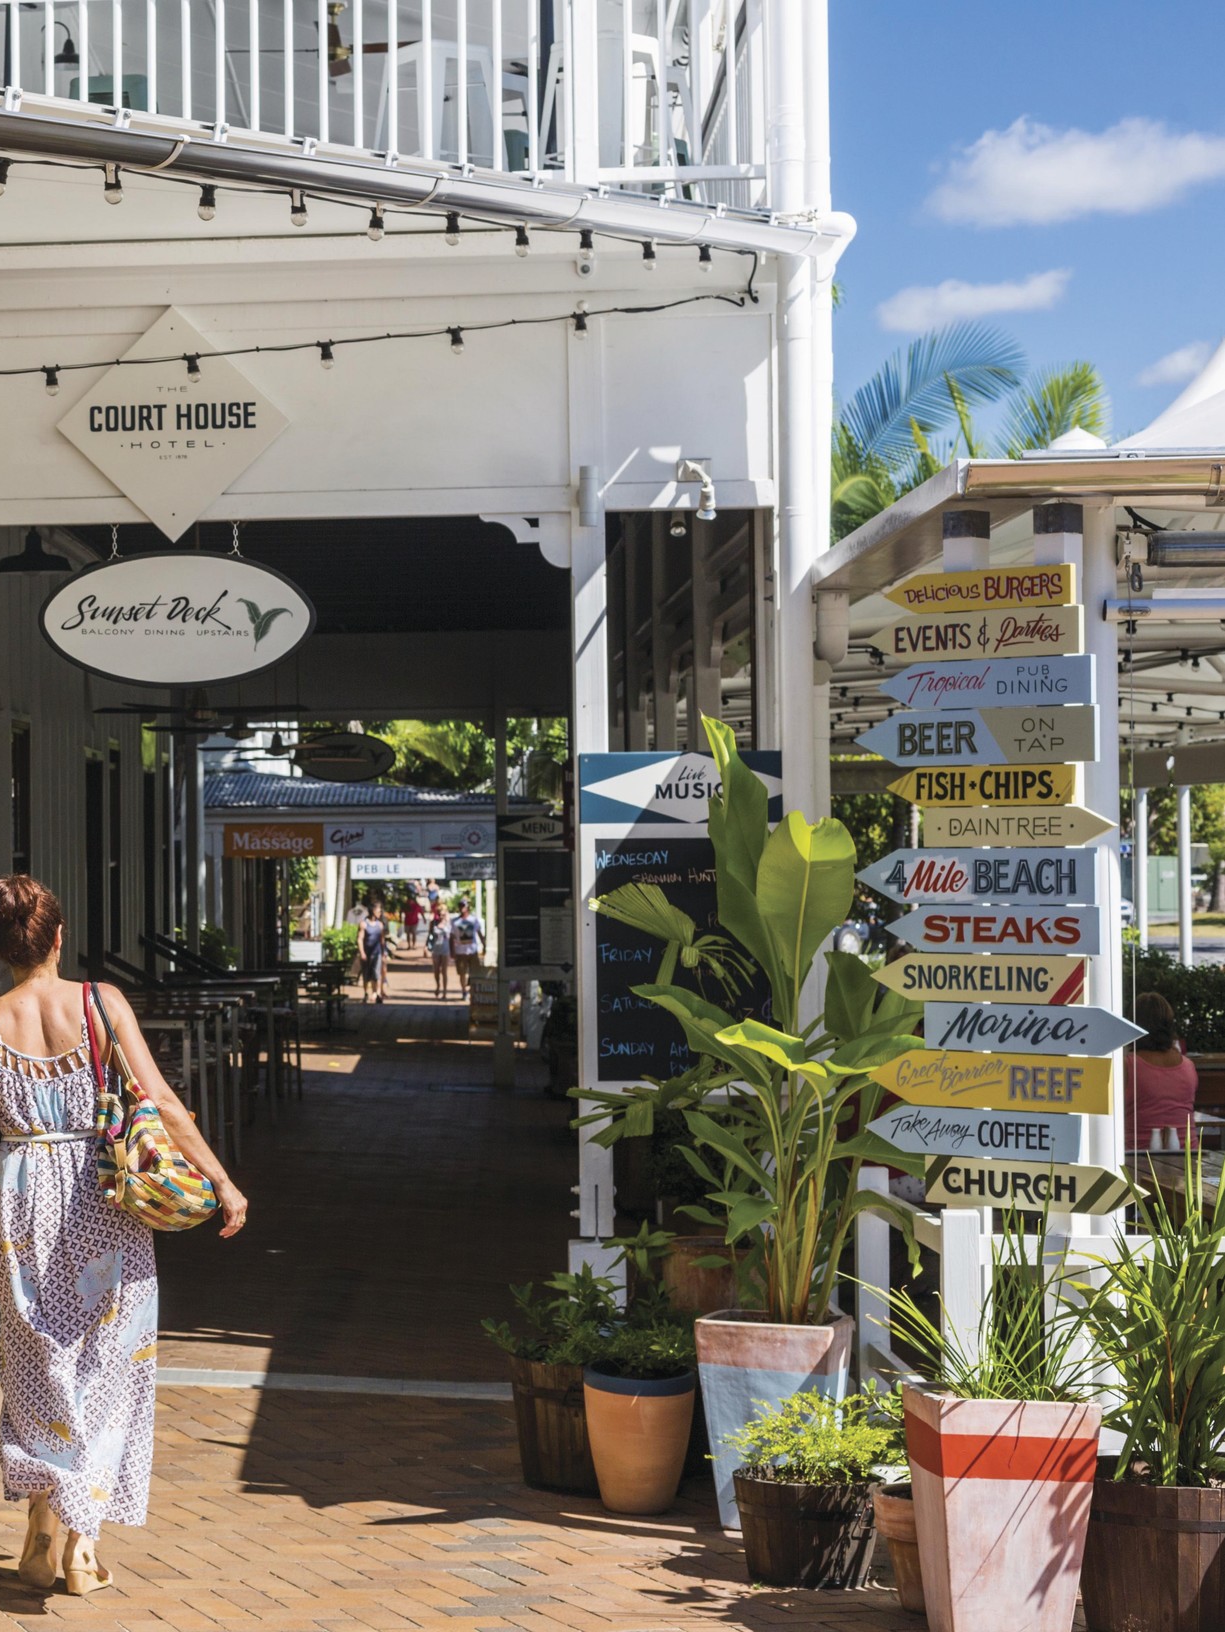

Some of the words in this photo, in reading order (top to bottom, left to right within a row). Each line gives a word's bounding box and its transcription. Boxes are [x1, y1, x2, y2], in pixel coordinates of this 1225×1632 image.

[156, 385, 189, 393] THE
[89, 404, 167, 432] COURT
[176, 402, 257, 430] HOUSE
[130, 440, 215, 449] HOTEL
[984, 573, 1064, 602] BURGERS
[61, 594, 169, 631] Sunset
[171, 590, 232, 631] Deck
[81, 628, 135, 636] BALCONY
[196, 629, 250, 637] UPSTAIRS
[894, 623, 971, 653] EVENTS
[978, 617, 990, 653] &
[994, 613, 1066, 652] Parties
[1016, 664, 1051, 677] PUB
[907, 666, 992, 706] Tropical
[996, 678, 1069, 696] DINING
[1021, 718, 1056, 732] ON
[897, 721, 978, 757] BEER
[1014, 737, 1065, 752] TAP
[678, 765, 707, 782] Live
[915, 772, 966, 800] FISH
[520, 821, 556, 835] MENU
[949, 816, 1063, 840] DAINTREE
[232, 832, 314, 854] Massage
[356, 864, 400, 874] PEBLE
[595, 849, 669, 869] WEDNESDAY
[886, 860, 907, 893] 4
[903, 860, 969, 898] Mile
[975, 858, 1077, 896] BEACH
[923, 914, 1081, 944] STEAKS
[598, 942, 652, 963] FRIDAY
[903, 964, 1049, 992] SNORKELING
[600, 1037, 655, 1057] SUNDAY
[669, 1042, 690, 1058] AM
[896, 1054, 947, 1088] Great
[941, 1058, 1008, 1088] Barrier
[1009, 1065, 1084, 1102] REEF
[891, 1110, 928, 1146] Take
[927, 1120, 974, 1149] Away
[977, 1120, 1050, 1150] COFFEE
[942, 1166, 1077, 1204] CHURCH
